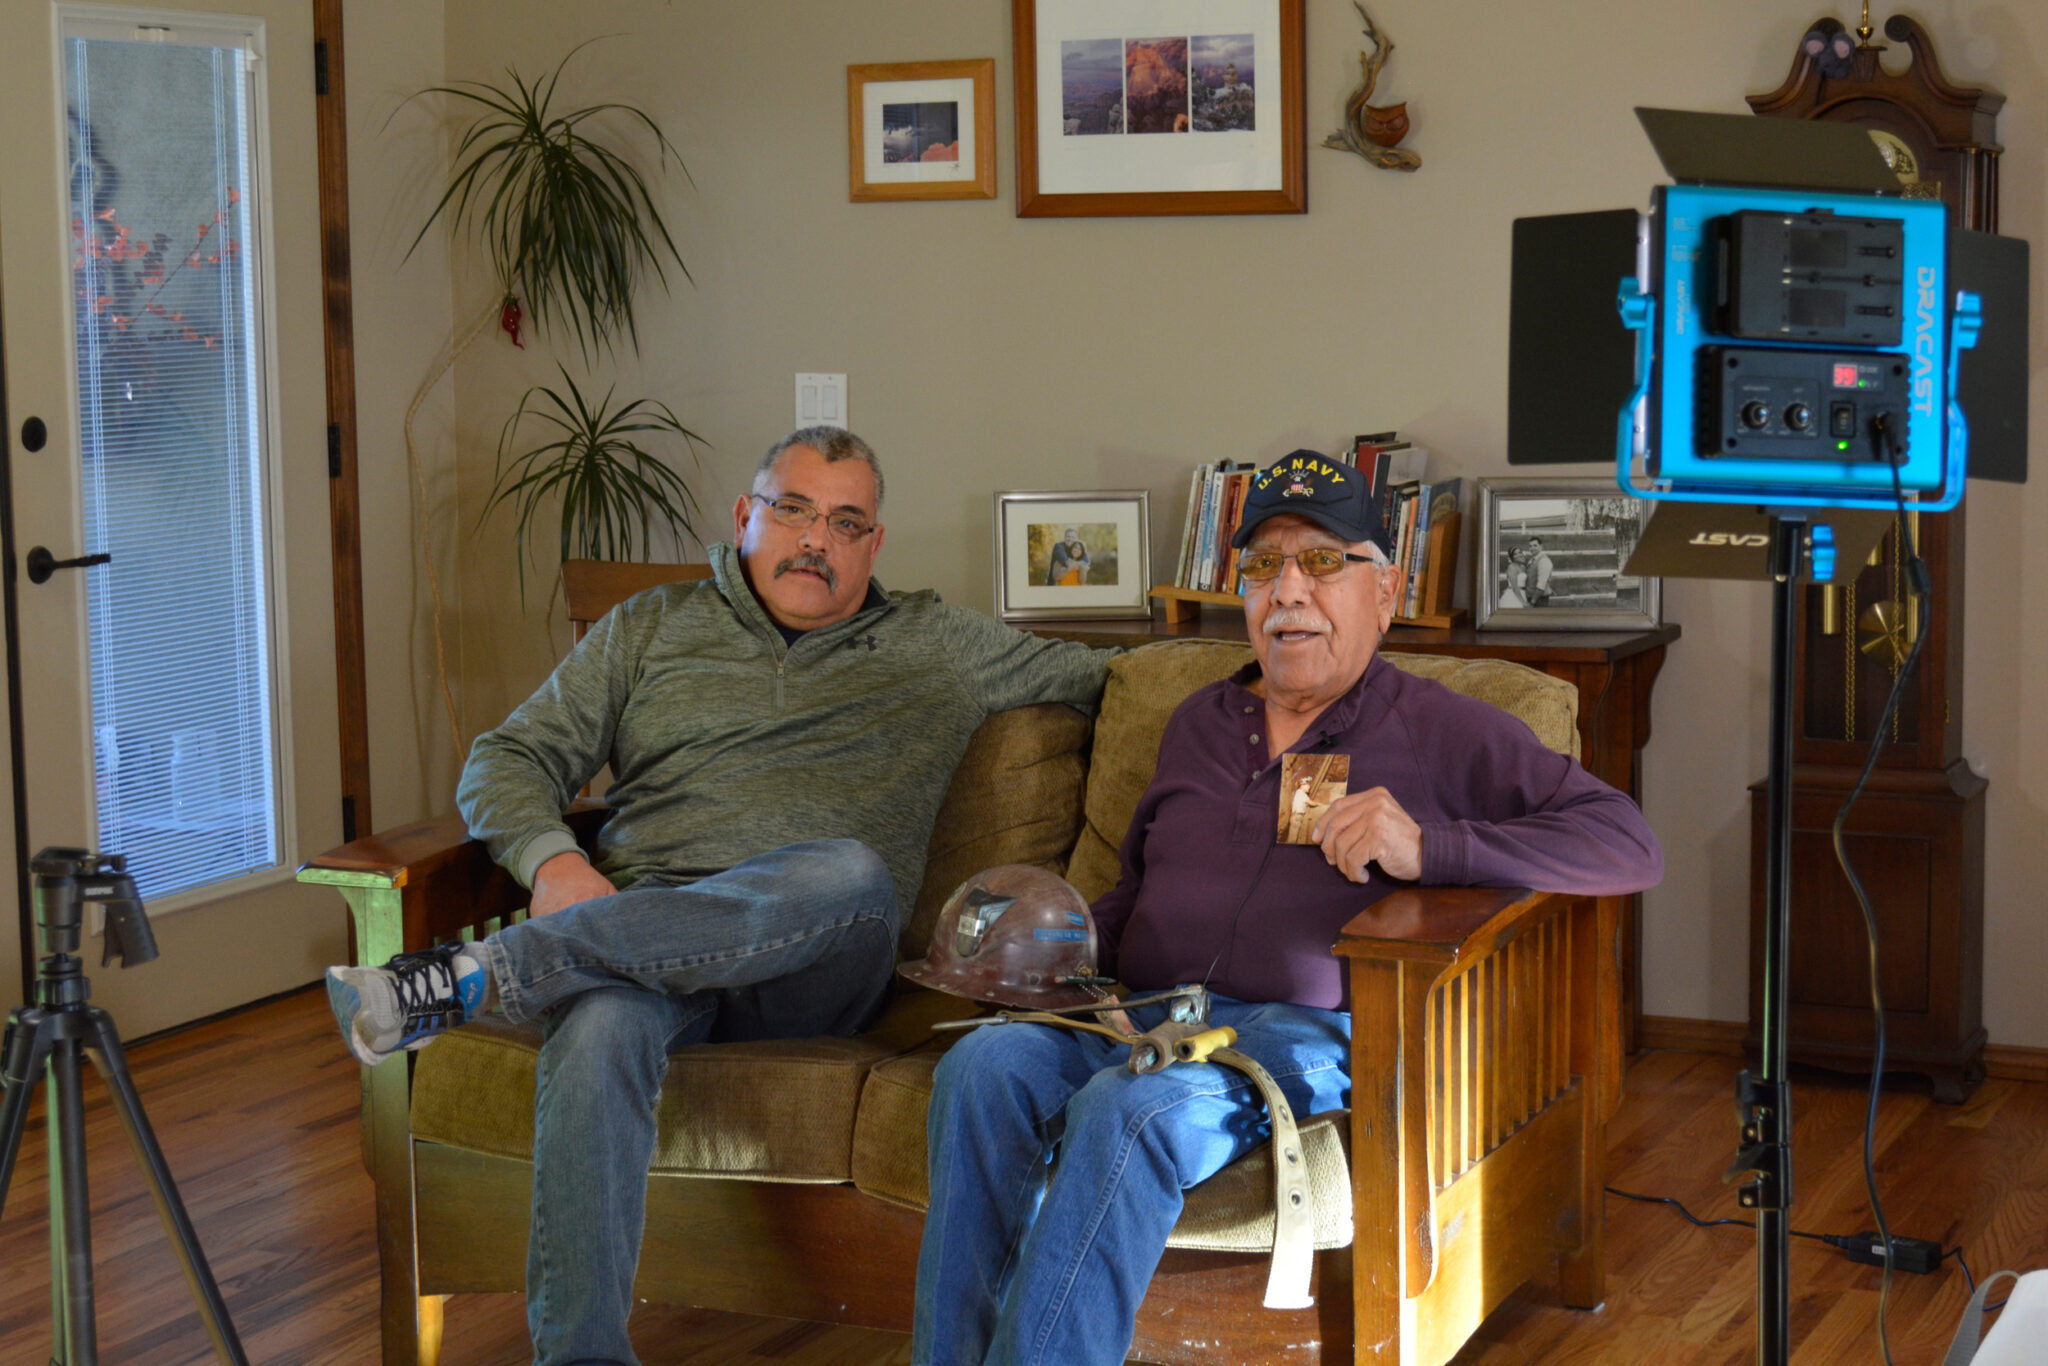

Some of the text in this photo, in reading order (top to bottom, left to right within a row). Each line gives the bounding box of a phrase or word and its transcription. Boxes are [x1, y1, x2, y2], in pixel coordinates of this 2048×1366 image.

[1914, 265, 1935, 418] DRACAST
[1258, 458, 1345, 490] U.S. NAVY
[1689, 532, 1769, 547] CAST
